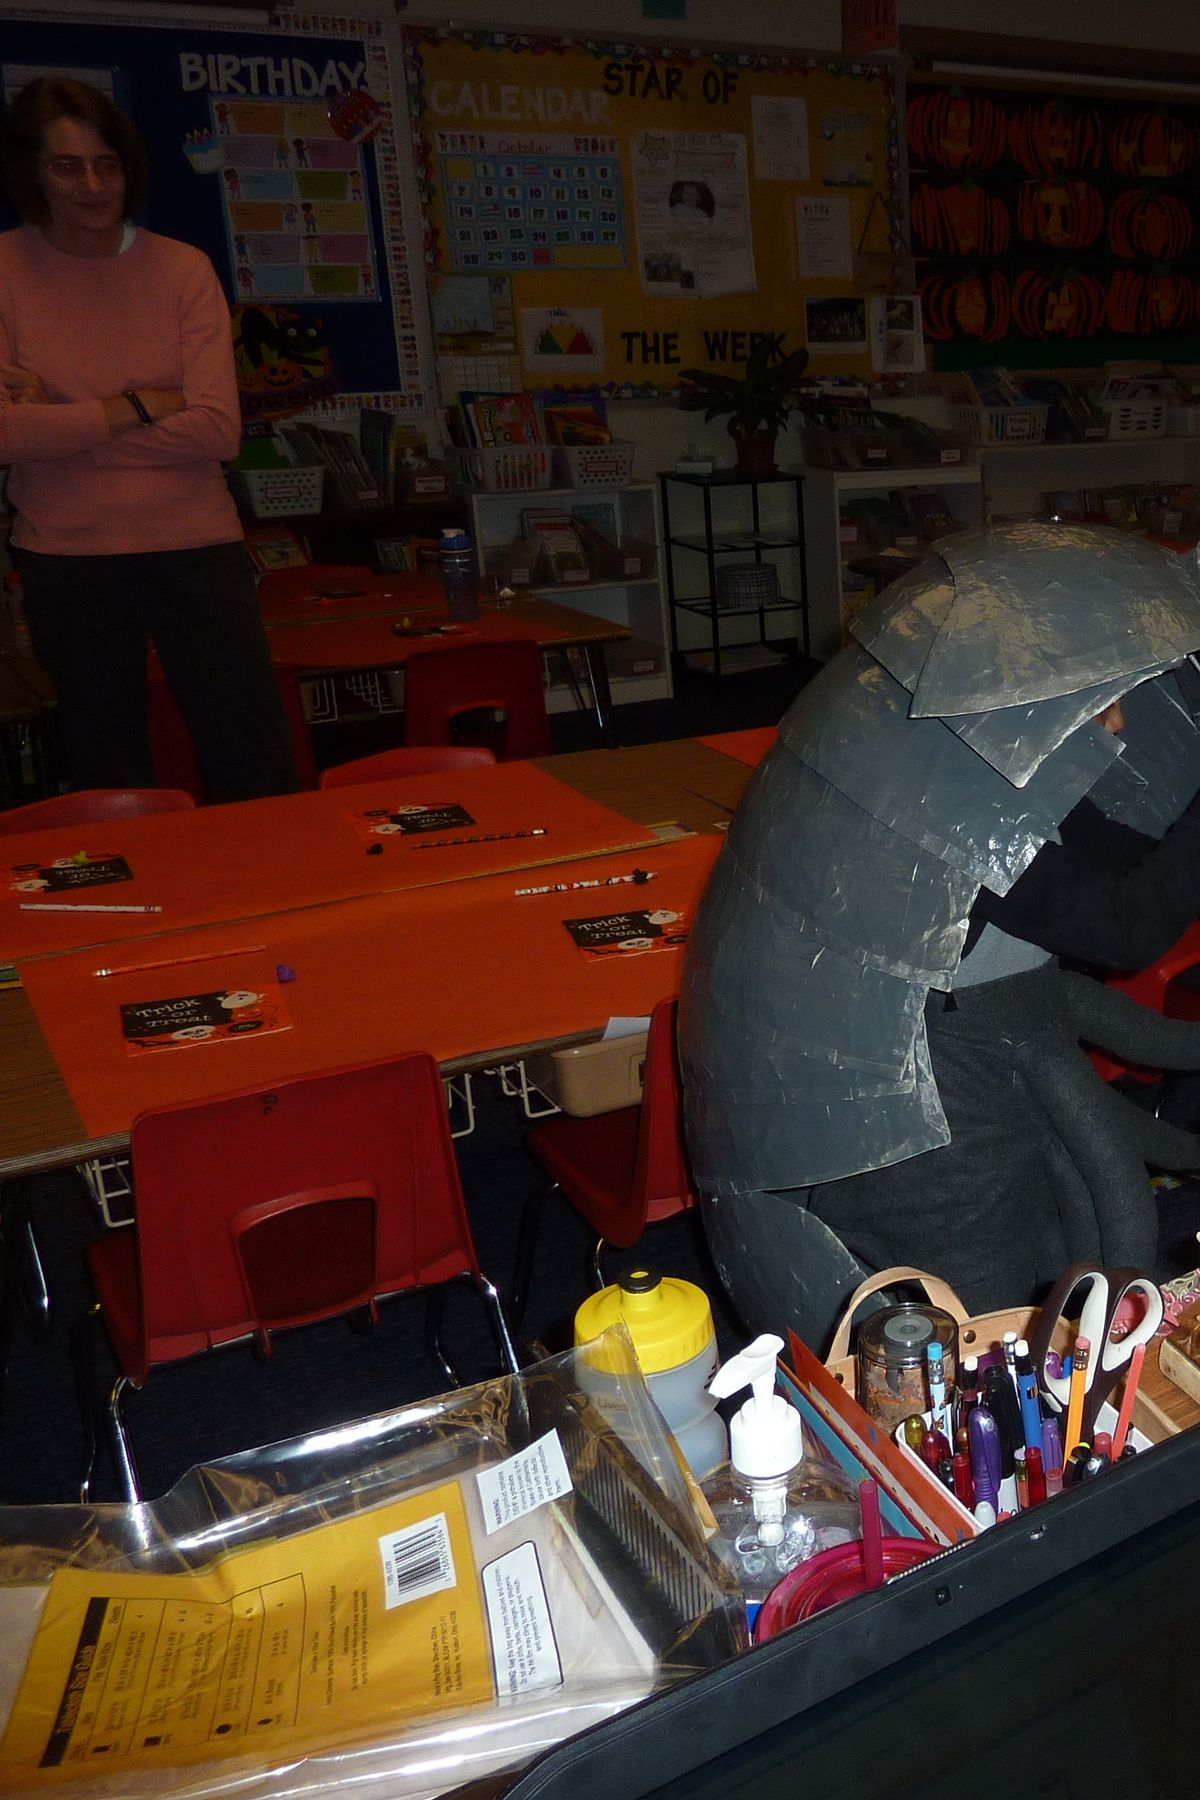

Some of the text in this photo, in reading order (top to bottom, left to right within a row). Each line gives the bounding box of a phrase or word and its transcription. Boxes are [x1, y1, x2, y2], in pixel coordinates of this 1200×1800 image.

[602, 62, 738, 104] STAR OF
[429, 80, 614, 126] CALENDAR
[483, 165, 608, 179] 1 2 4 5 6
[458, 186, 613, 199] 7 8 9 10 11 12 13
[459, 206, 616, 222] 14 16 17 18 19 20
[459, 229, 616, 242] 21 22 23 24 25 26 27
[463, 251, 525, 265] 28 29 30
[621, 331, 681, 364] THE
[578, 915, 632, 932] Trick
[590, 928, 647, 939] Treat
[135, 998, 203, 1018] Trick
[170, 1008, 198, 1018] or
[145, 1014, 213, 1028] Treat
